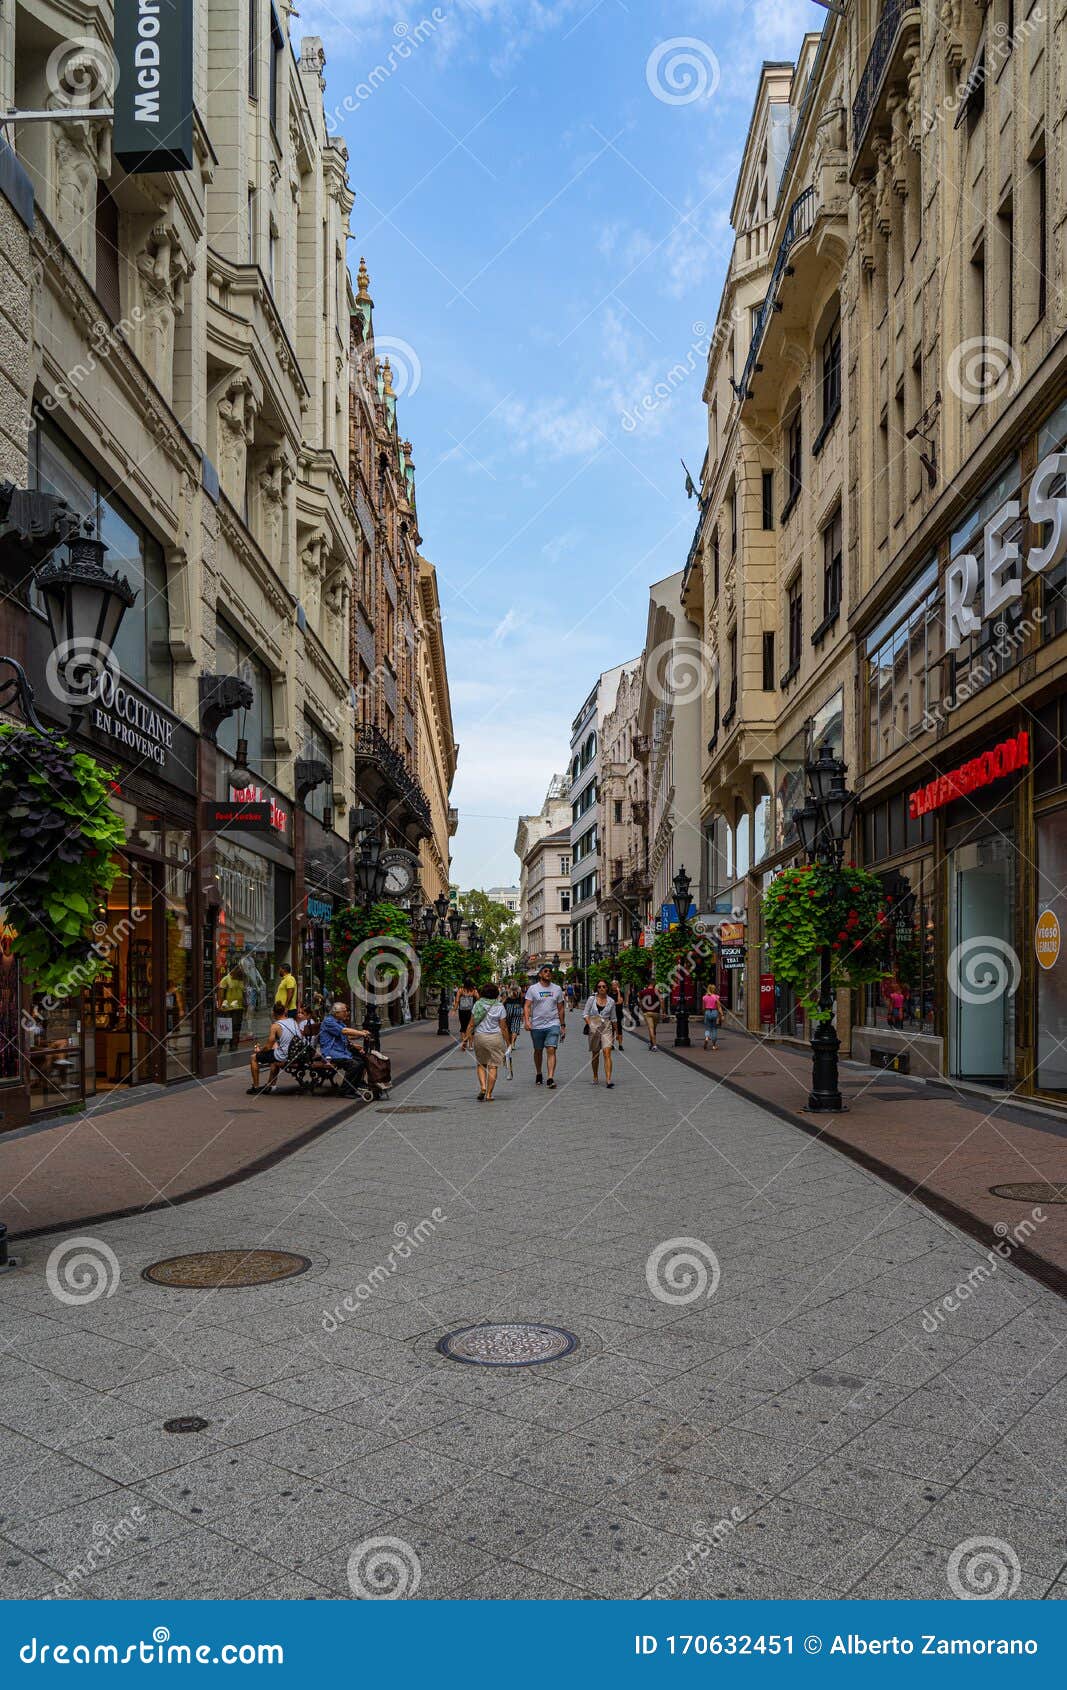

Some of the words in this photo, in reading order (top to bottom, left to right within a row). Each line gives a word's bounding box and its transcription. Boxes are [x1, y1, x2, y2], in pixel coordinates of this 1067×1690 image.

[946, 452, 1067, 653] RES
[95, 708, 112, 734] EN
[115, 720, 166, 768] PROVENCE
